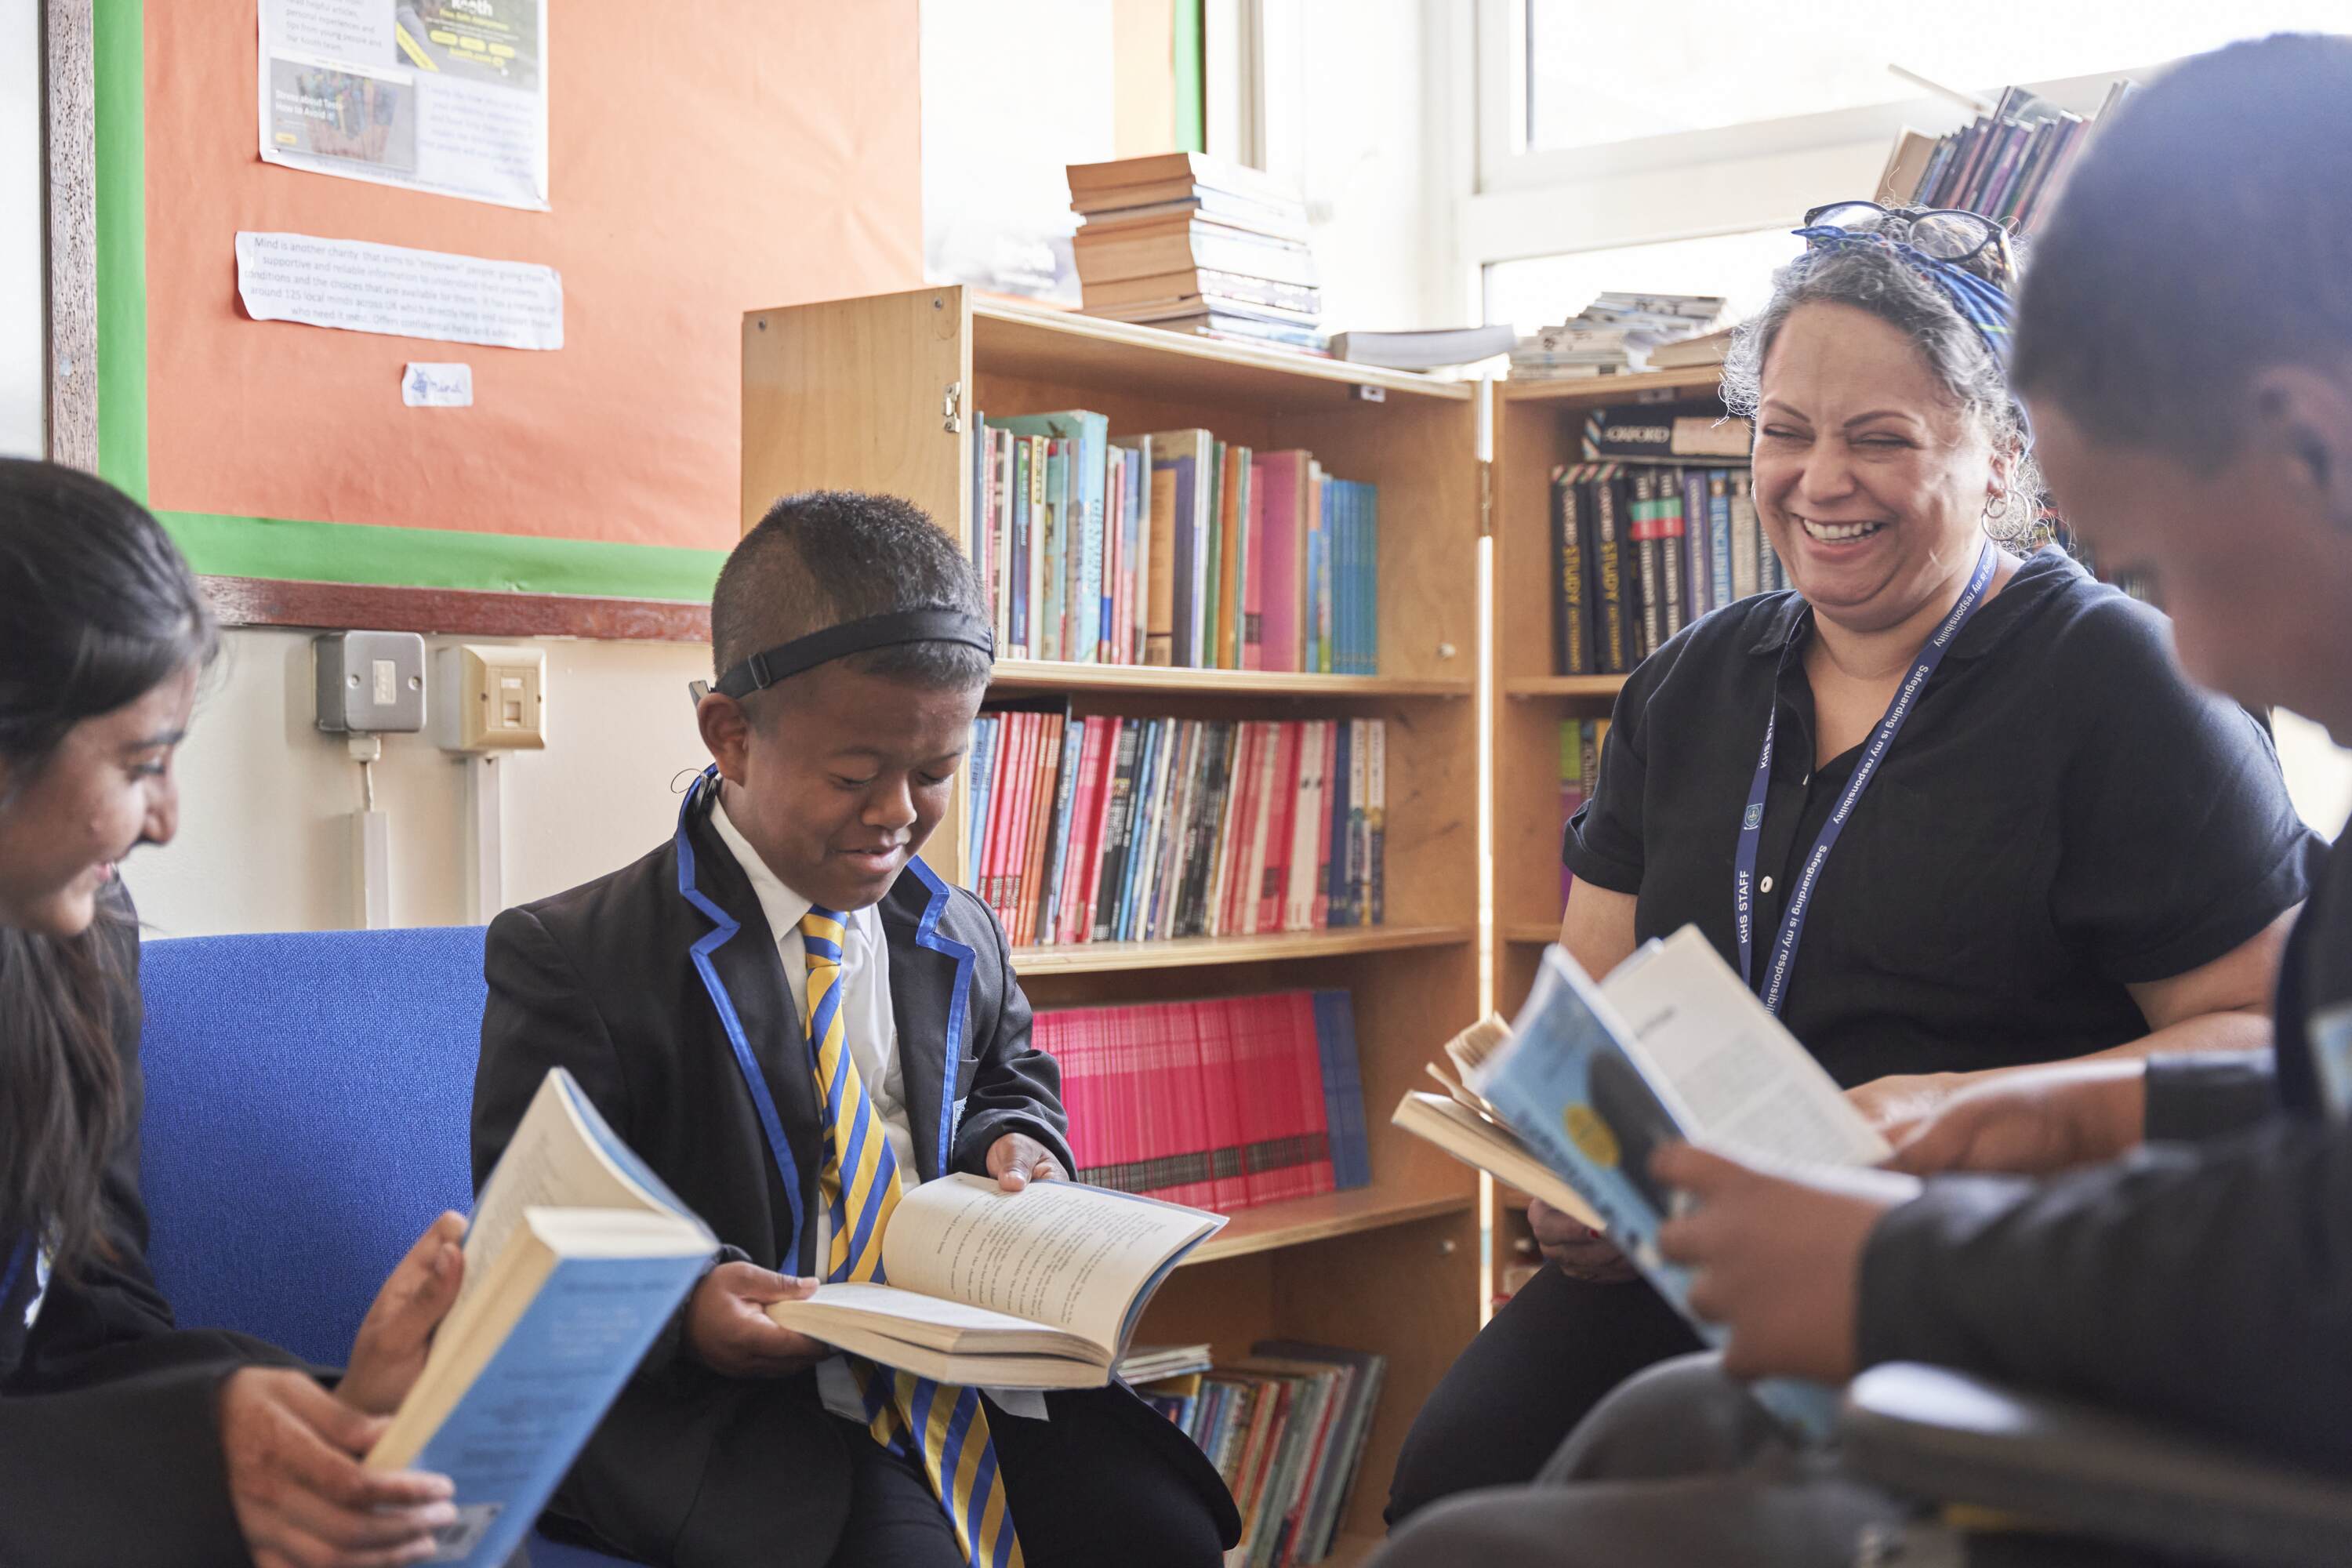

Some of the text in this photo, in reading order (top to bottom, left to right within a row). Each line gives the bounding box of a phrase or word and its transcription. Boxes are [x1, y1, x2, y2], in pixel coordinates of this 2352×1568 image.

[254, 238, 278, 249] Mind
[290, 244, 325, 255] another
[263, 256, 311, 269] supportive
[314, 262, 331, 272] and
[333, 264, 365, 276] reliable
[367, 267, 416, 281] information
[244, 269, 291, 283] conditions
[293, 275, 311, 285] and
[312, 276, 328, 287] the
[330, 279, 362, 291] choices
[365, 282, 383, 293] that
[384, 287, 398, 296] are
[251, 285, 283, 298] around
[285, 288, 302, 300] 125
[303, 291, 325, 302] local
[327, 294, 353, 306] minds
[356, 299, 383, 308] across
[290, 306, 311, 317] who
[313, 309, 336, 320] need
[1607, 424, 1671, 445] OXFORD
[1563, 545, 1582, 603] STUDY
[1600, 541, 1621, 602] STUDY
[1972, 581, 1983, 594] my
[1933, 593, 1976, 648] responsibility
[1885, 665, 1929, 728] Safeguarding
[1760, 743, 1770, 769] KHS
[1871, 741, 1884, 757] my
[1833, 758, 1875, 824] responsibility
[1739, 870, 1750, 944] KHS STAFF
[1765, 845, 1828, 1016] Safeguarding is my responsibili
